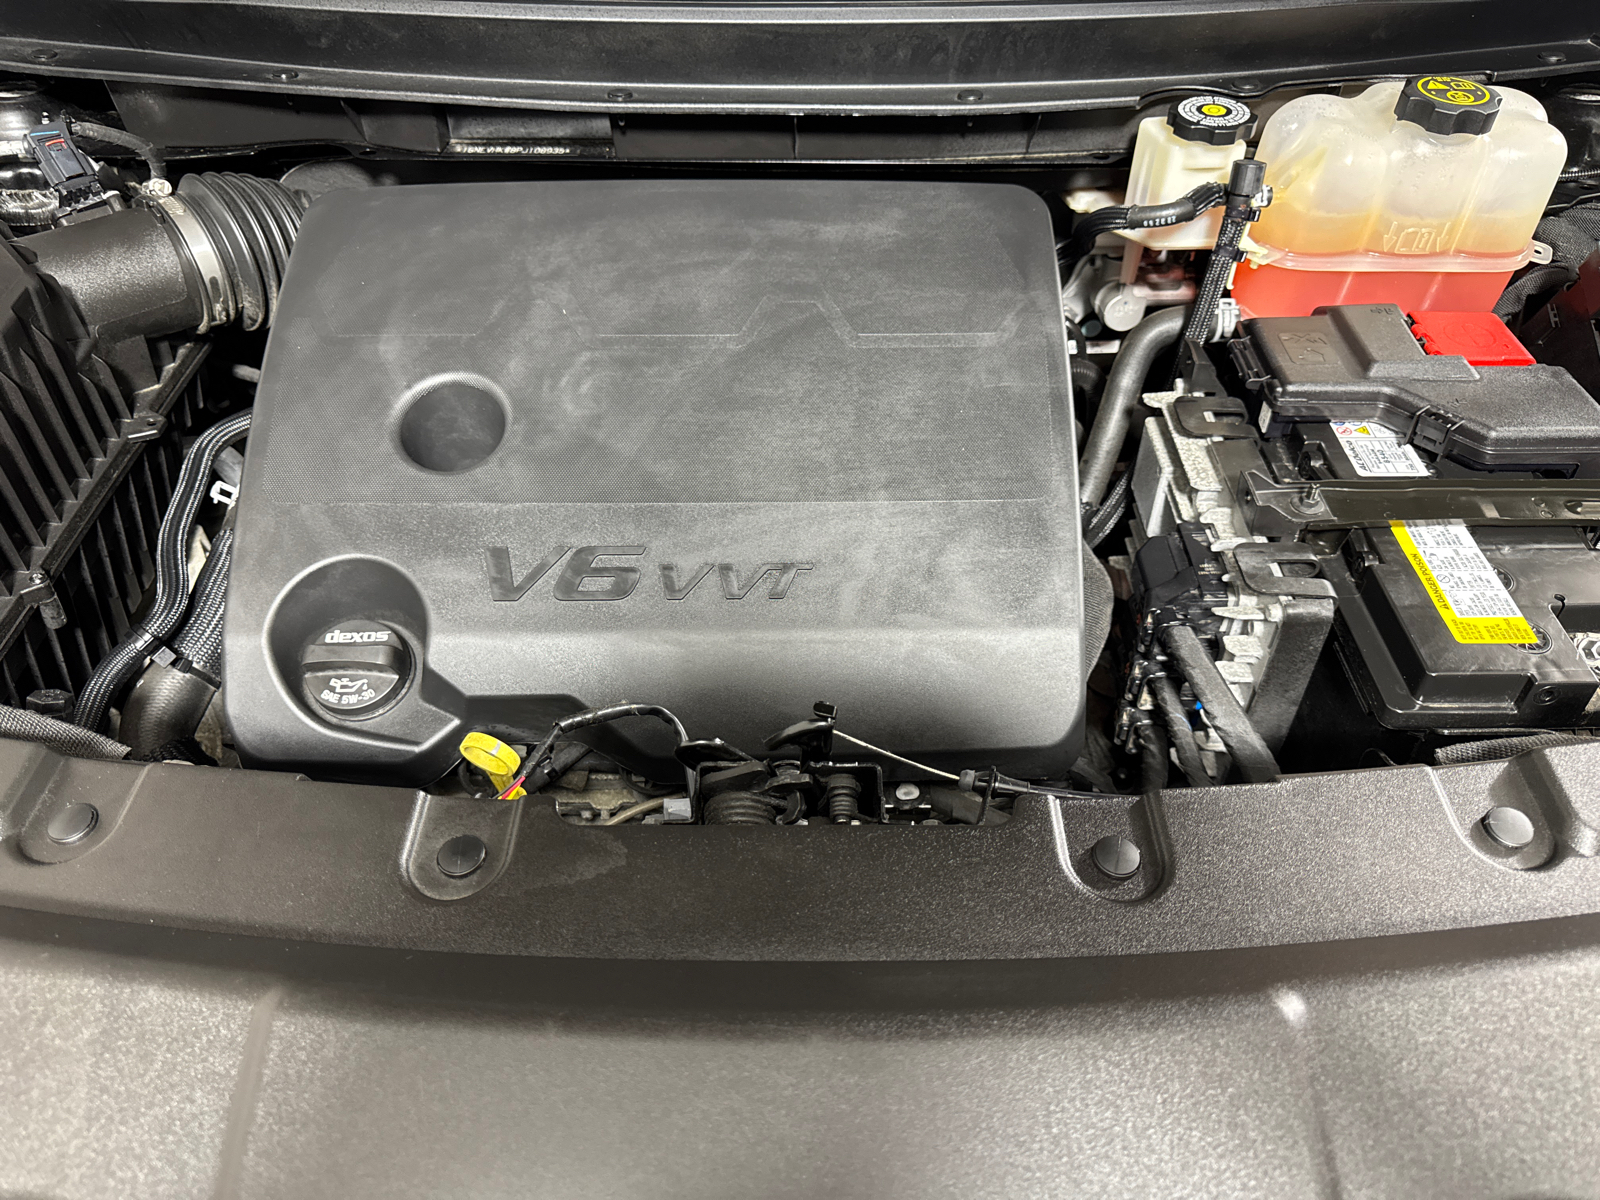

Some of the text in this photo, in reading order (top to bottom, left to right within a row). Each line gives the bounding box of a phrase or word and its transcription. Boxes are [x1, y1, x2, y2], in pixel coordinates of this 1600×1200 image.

[485, 545, 815, 602] V6 VVT
[325, 629, 391, 643] dexos
[321, 688, 376, 705] SAE 5W-30
